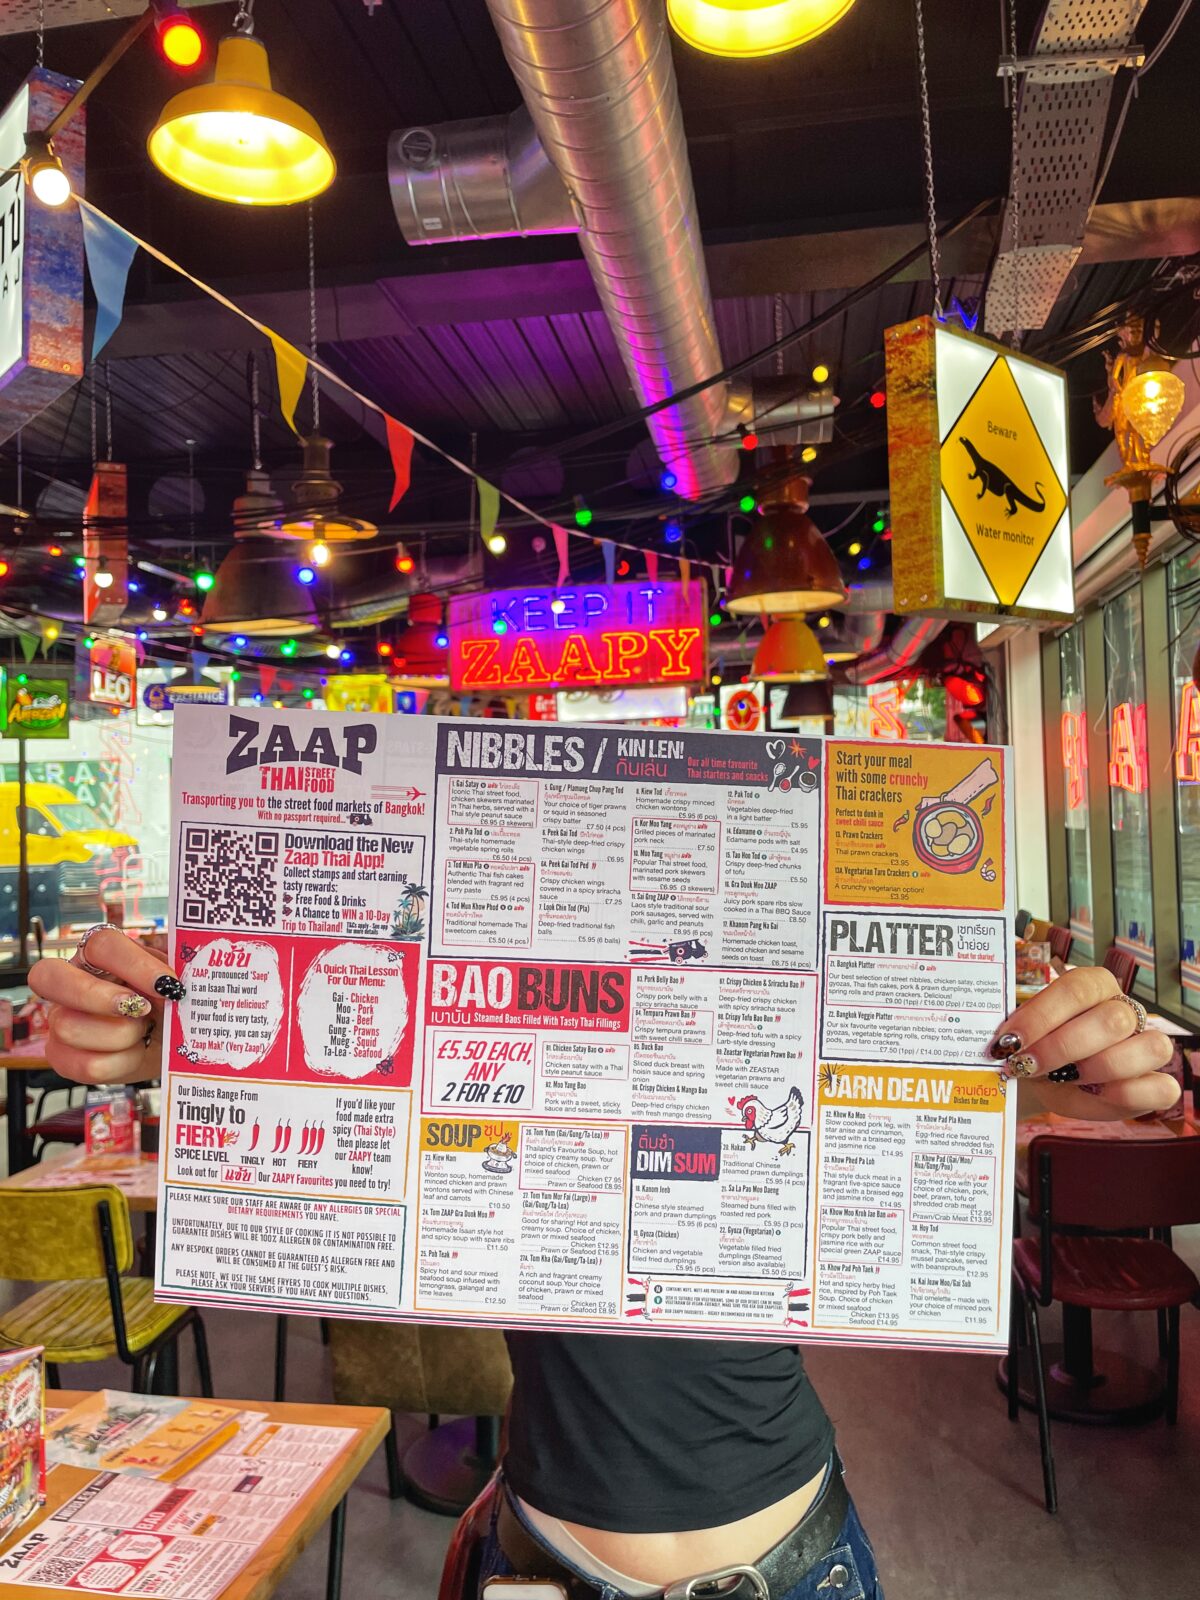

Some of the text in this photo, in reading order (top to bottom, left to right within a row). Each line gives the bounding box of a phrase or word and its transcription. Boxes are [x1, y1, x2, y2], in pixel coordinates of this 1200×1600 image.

[987, 420, 1018, 440] Beware
[976, 522, 1035, 546] Water monitor
[491, 589, 664, 632] KEEP IT
[462, 629, 699, 685] ZAAPY
[94, 670, 130, 702] LEO
[226, 714, 377, 775] ZAAP
[446, 730, 585, 773] NIBBLES
[617, 738, 684, 760] KIN LEN!
[836, 751, 911, 769] Start your meal
[260, 766, 336, 791] THAI STREET
[305, 779, 334, 793] FOOD
[836, 769, 927, 789] with some crunchy
[835, 786, 902, 802] Thai crackers
[182, 792, 424, 817] Transporting you to the street food markets of Bangkok!
[257, 810, 272, 819] With
[283, 813, 311, 823] passport
[284, 833, 413, 853] Download the New
[284, 849, 384, 869] Zaap Thai App!
[283, 867, 407, 884] Collect stamps and start earning
[283, 881, 337, 893] tasty rewards:
[295, 894, 312, 904] Free
[314, 895, 331, 905] Food
[341, 896, 366, 906] Drinks
[295, 907, 300, 917] A
[302, 907, 329, 918] Chance
[331, 908, 339, 918] to
[342, 908, 356, 919] WIN
[365, 909, 390, 922] 10-Day
[282, 920, 342, 933] Trip to Thailand!
[830, 919, 954, 956] PLATTER
[314, 963, 400, 976] A Quick Thai Lesson
[327, 975, 385, 986] For Our Menu:
[431, 964, 624, 1014] BAO BUNS
[474, 1012, 620, 1030] Steamed Baos Filled With Tasty Thai Fillings
[437, 1039, 533, 1065] £5.50 EACH,
[464, 1063, 505, 1081] ANY
[441, 1082, 456, 1102] 2
[456, 1083, 490, 1103] FOR
[492, 1085, 525, 1103] £10
[824, 1072, 953, 1104] JARN DEAW
[177, 1101, 246, 1125] Tingly to
[176, 1124, 226, 1148] FIERY
[427, 1123, 481, 1147] SOUP
[174, 1148, 229, 1162] SPICE LEVEL
[240, 1155, 264, 1164] TINGLY
[272, 1158, 286, 1166] HOT
[298, 1159, 317, 1168] FIERY
[636, 1150, 716, 1175] DIM SUM
